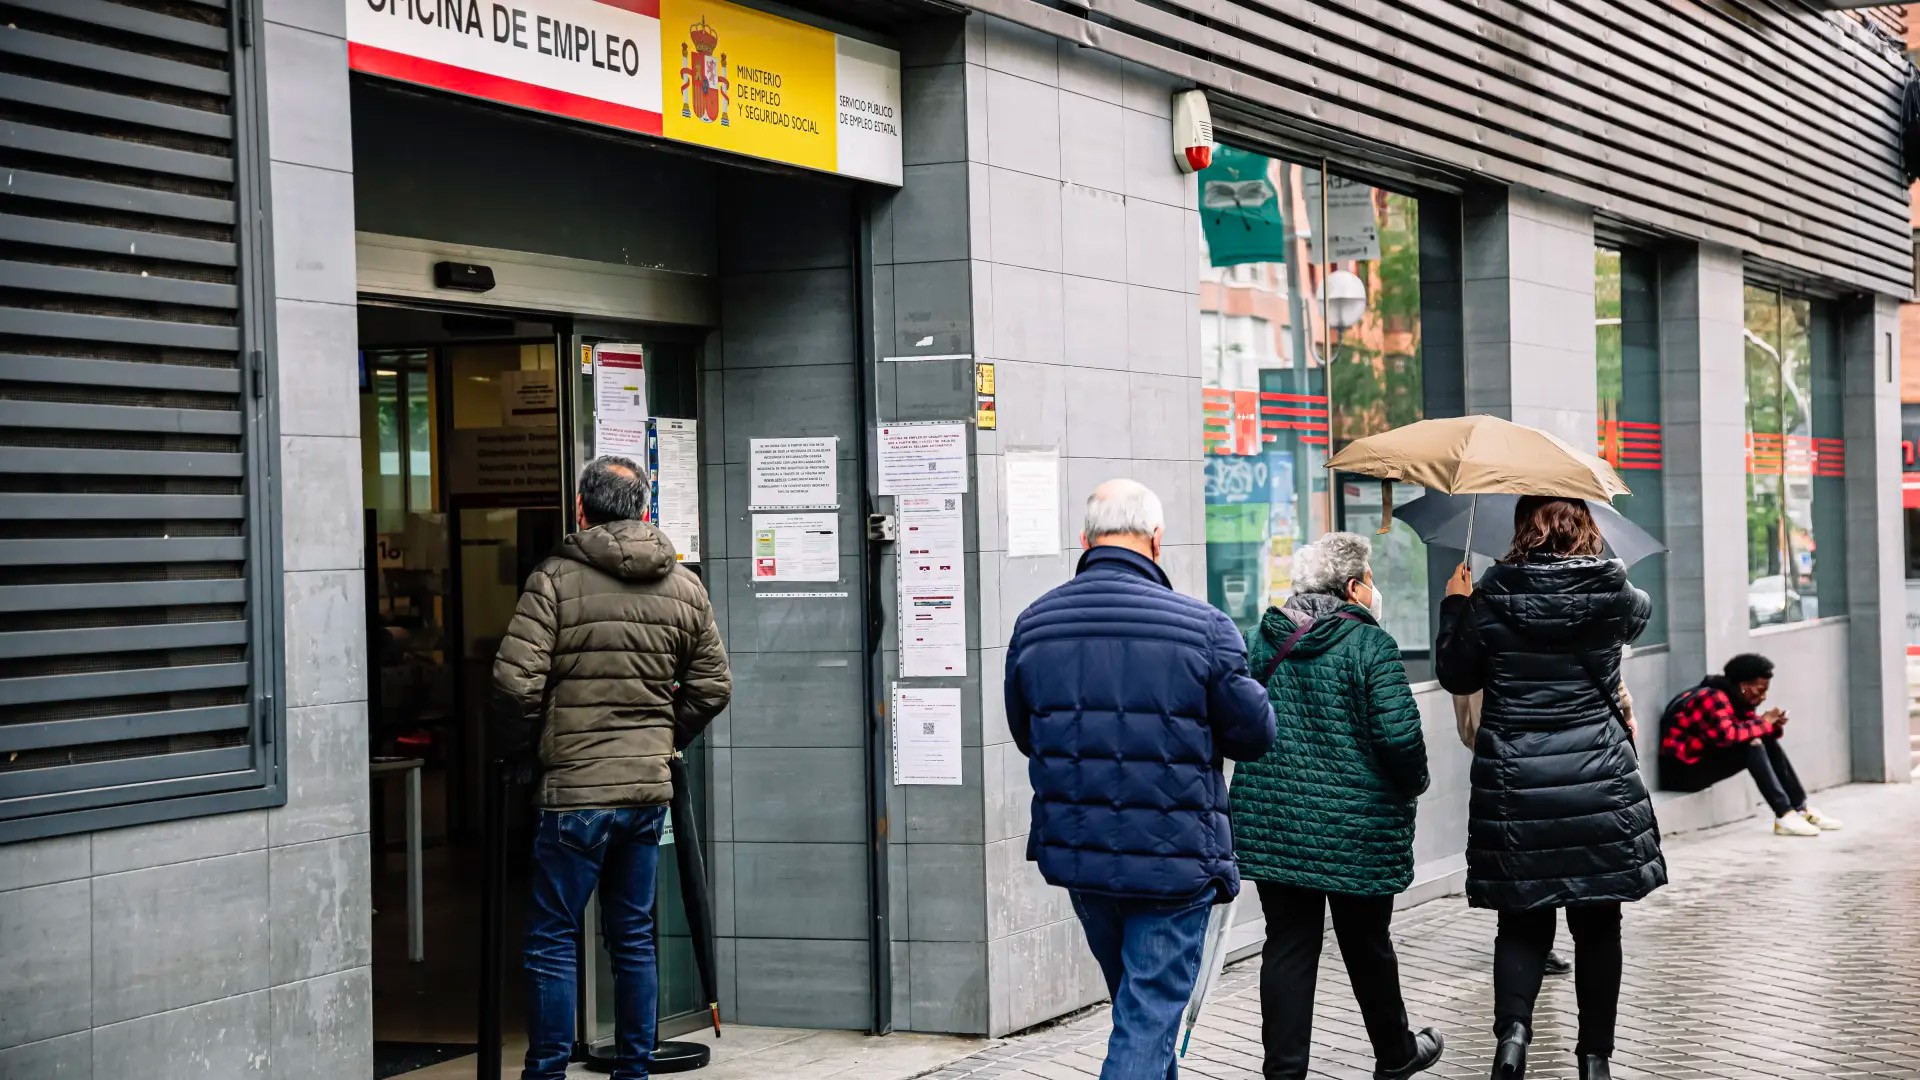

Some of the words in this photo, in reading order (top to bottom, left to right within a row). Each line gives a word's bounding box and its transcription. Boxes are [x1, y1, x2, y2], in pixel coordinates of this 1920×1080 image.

[493, 3, 528, 49] DE
[537, 15, 639, 77] EMPLEO
[736, 65, 782, 88] MINISTERIO
[737, 84, 749, 99] DE
[750, 88, 781, 107] EMPLEO
[839, 95, 866, 112] SERVICIO
[867, 99, 893, 118] PÚBLICO
[737, 103, 744, 117] Y
[745, 105, 790, 127] SEGURIDAD
[791, 115, 820, 135] SOCIAL
[839, 112, 849, 125] DE
[849, 114, 873, 131] EMPLEO
[874, 120, 898, 137] ESTATAL
